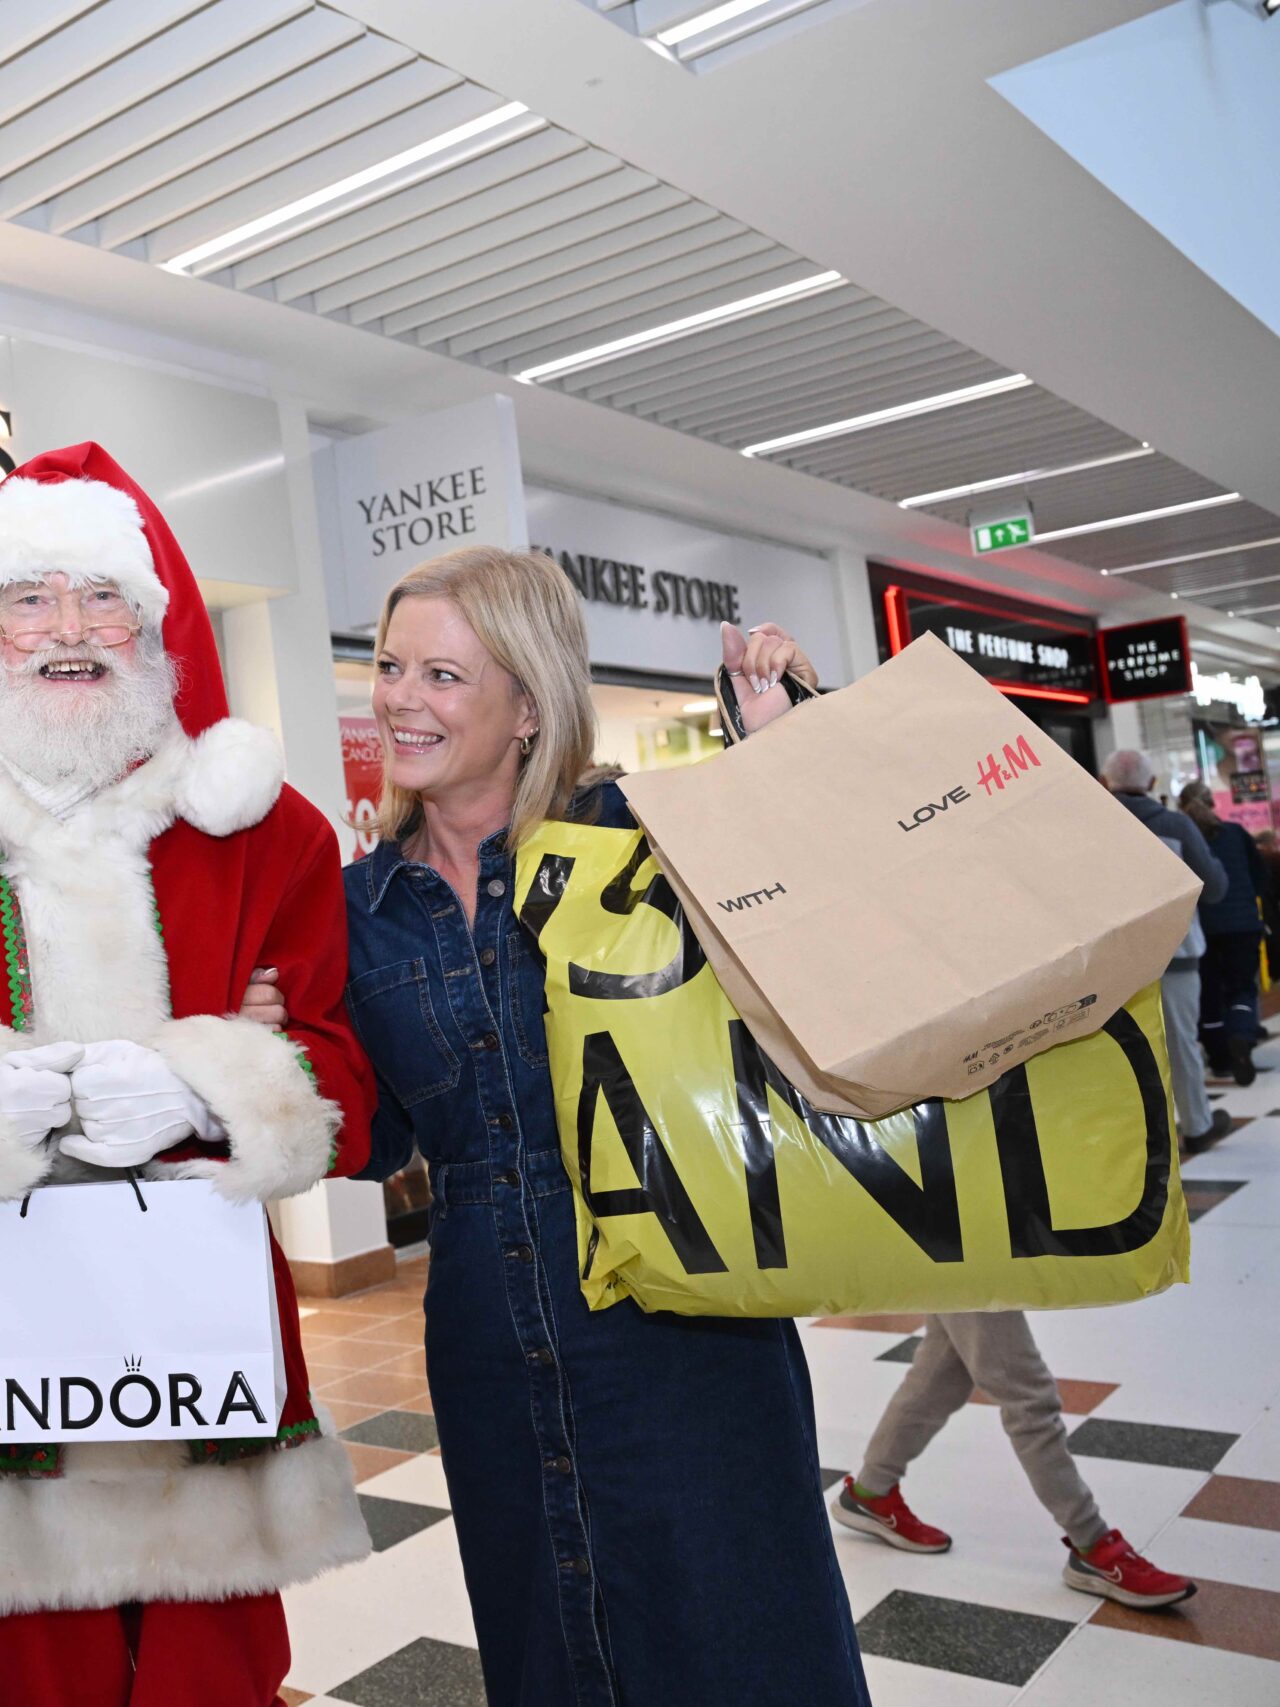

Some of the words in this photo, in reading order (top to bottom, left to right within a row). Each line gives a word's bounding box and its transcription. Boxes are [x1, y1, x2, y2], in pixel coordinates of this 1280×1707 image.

[357, 465, 487, 526] YANKEE
[371, 504, 477, 558] STORE
[531, 546, 648, 611] NKEE
[652, 570, 741, 626] STORE
[945, 626, 974, 654] THE
[978, 632, 1035, 664] PERFUME
[1037, 644, 1070, 669] SHOP
[1108, 648, 1181, 672] PERFUME
[1128, 640, 1158, 656] THE
[1123, 665, 1168, 682] SHOP
[897, 785, 971, 833] LOVE
[976, 734, 1041, 797] H&M
[716, 882, 788, 917] WITH
[581, 1006, 1173, 1280] AND
